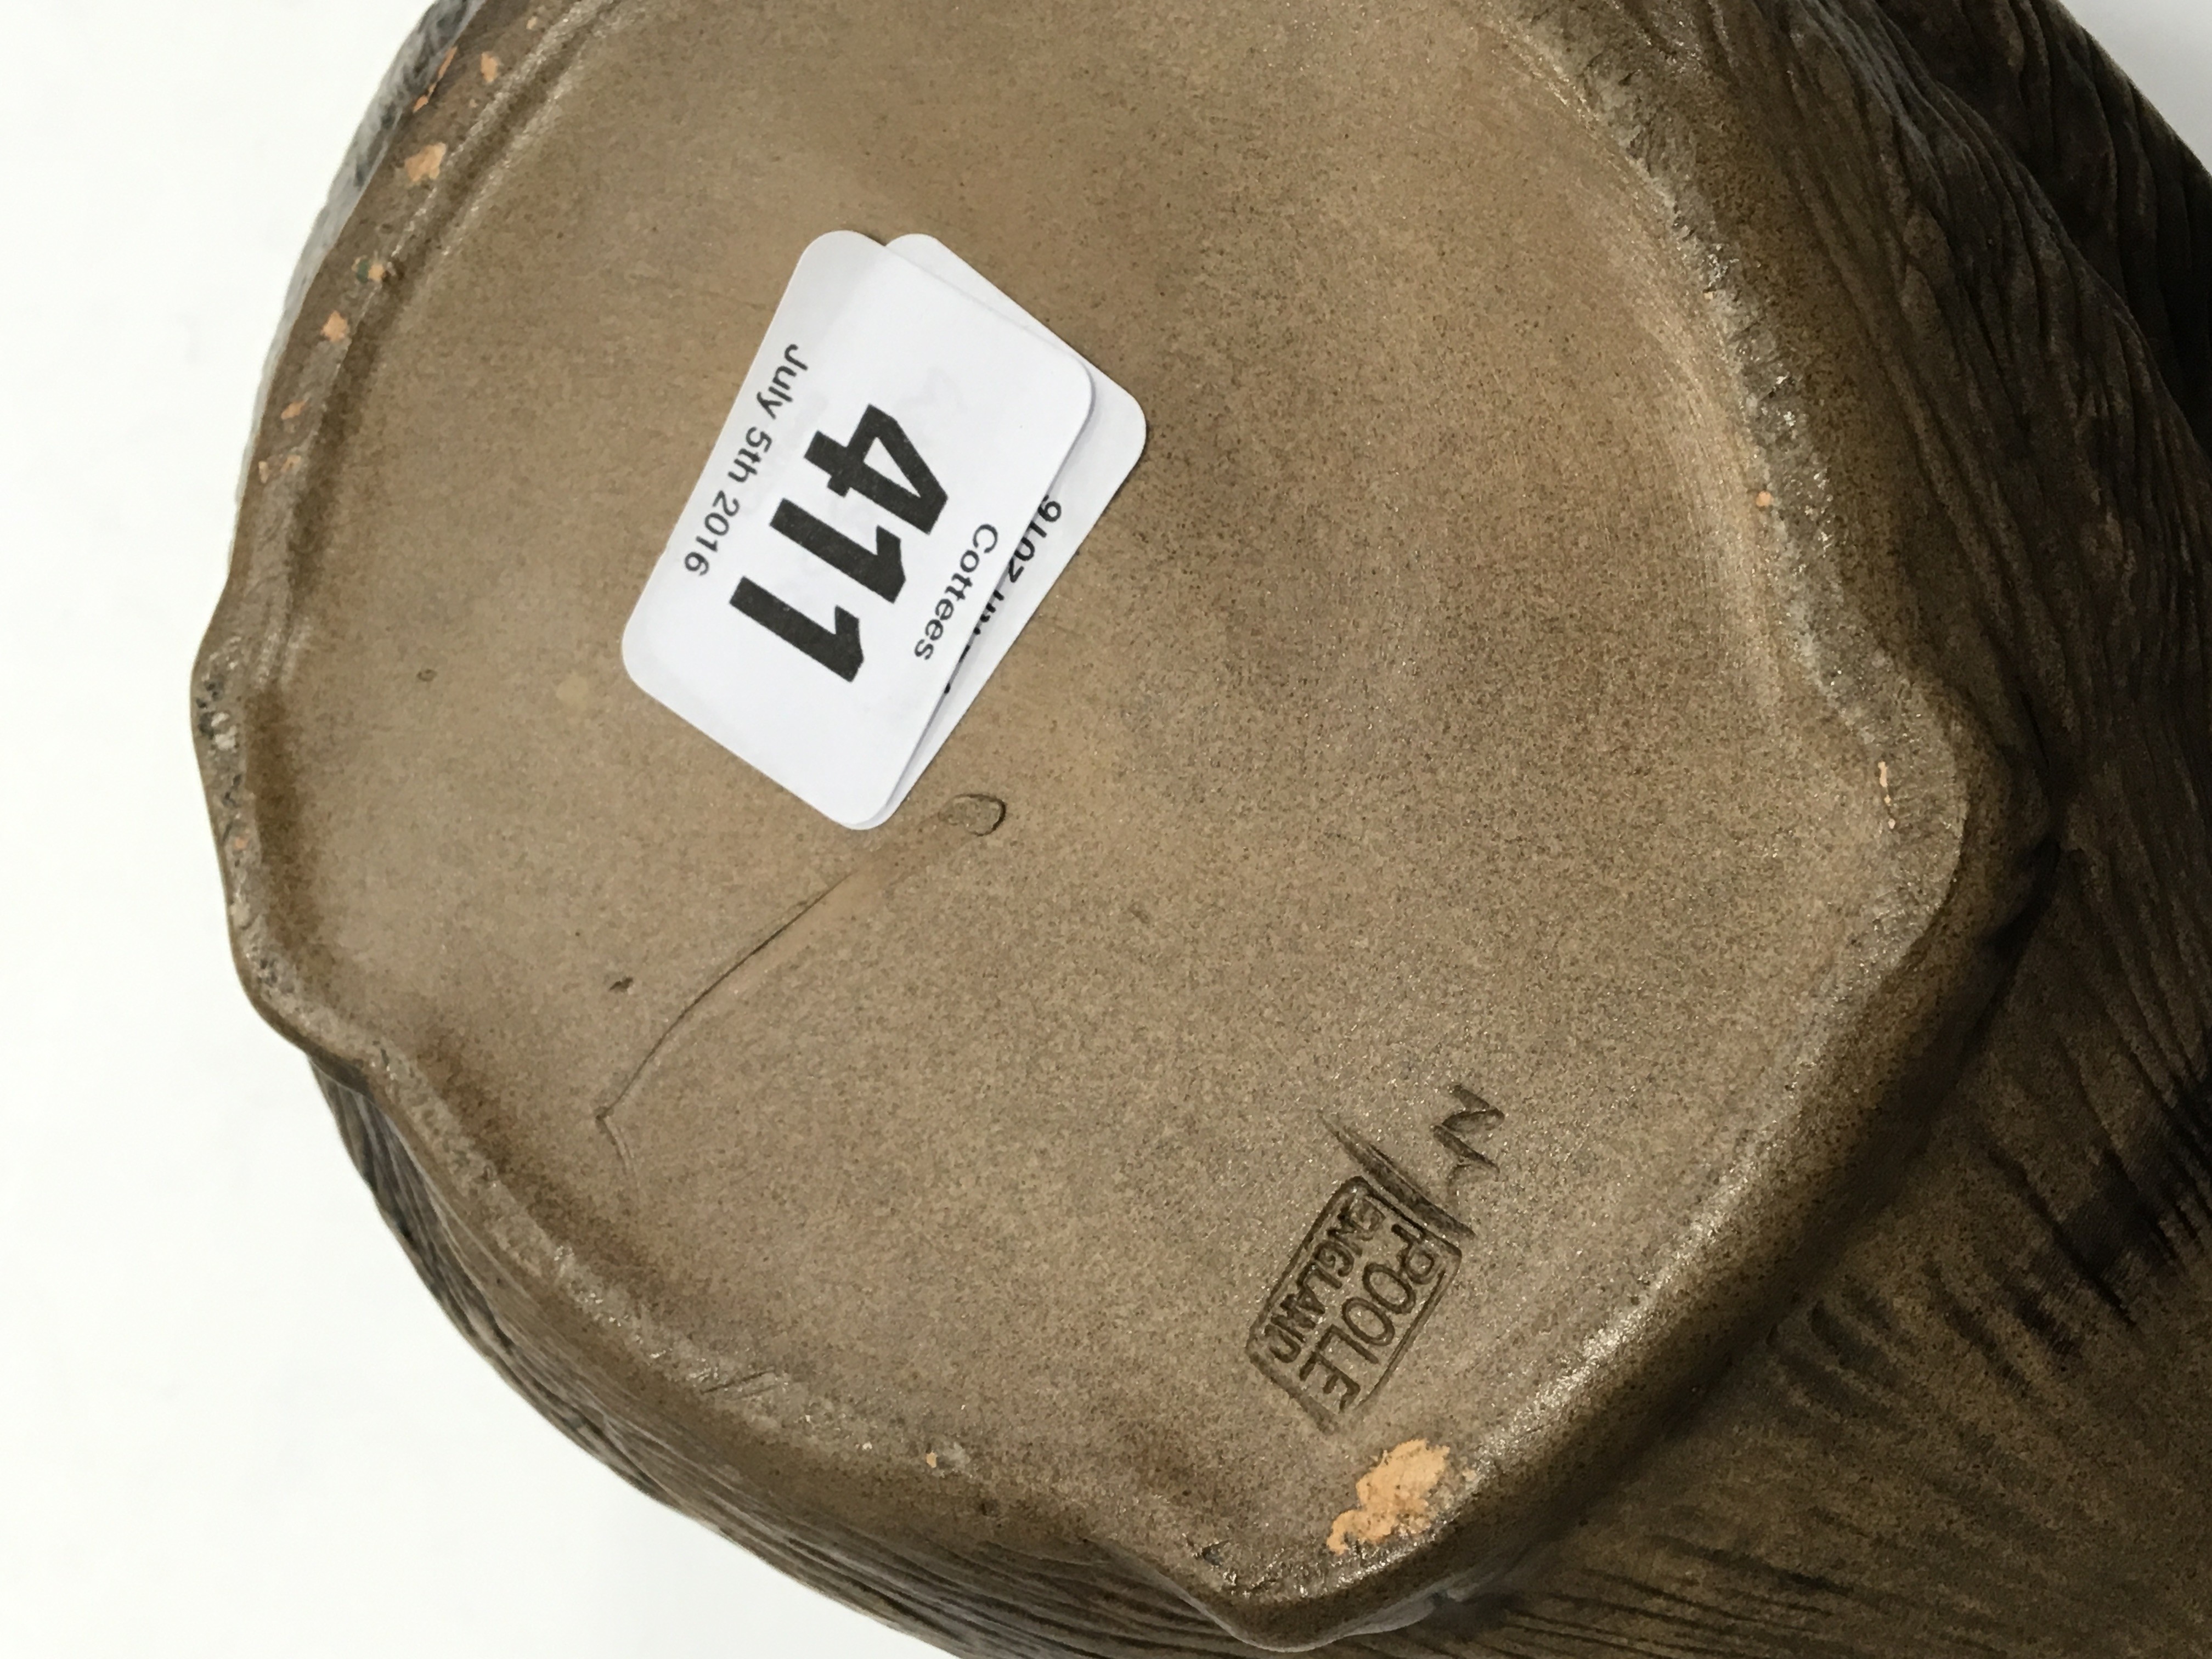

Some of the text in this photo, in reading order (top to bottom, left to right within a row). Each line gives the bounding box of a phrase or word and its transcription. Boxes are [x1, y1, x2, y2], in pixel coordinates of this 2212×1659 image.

[685, 344, 808, 575] July 5th 2016
[729, 404, 948, 682] 411
[915, 524, 998, 660] Cottees
[1264, 1193, 1387, 1364] ENGLAND
[1300, 1223, 1436, 1413] POOLE
